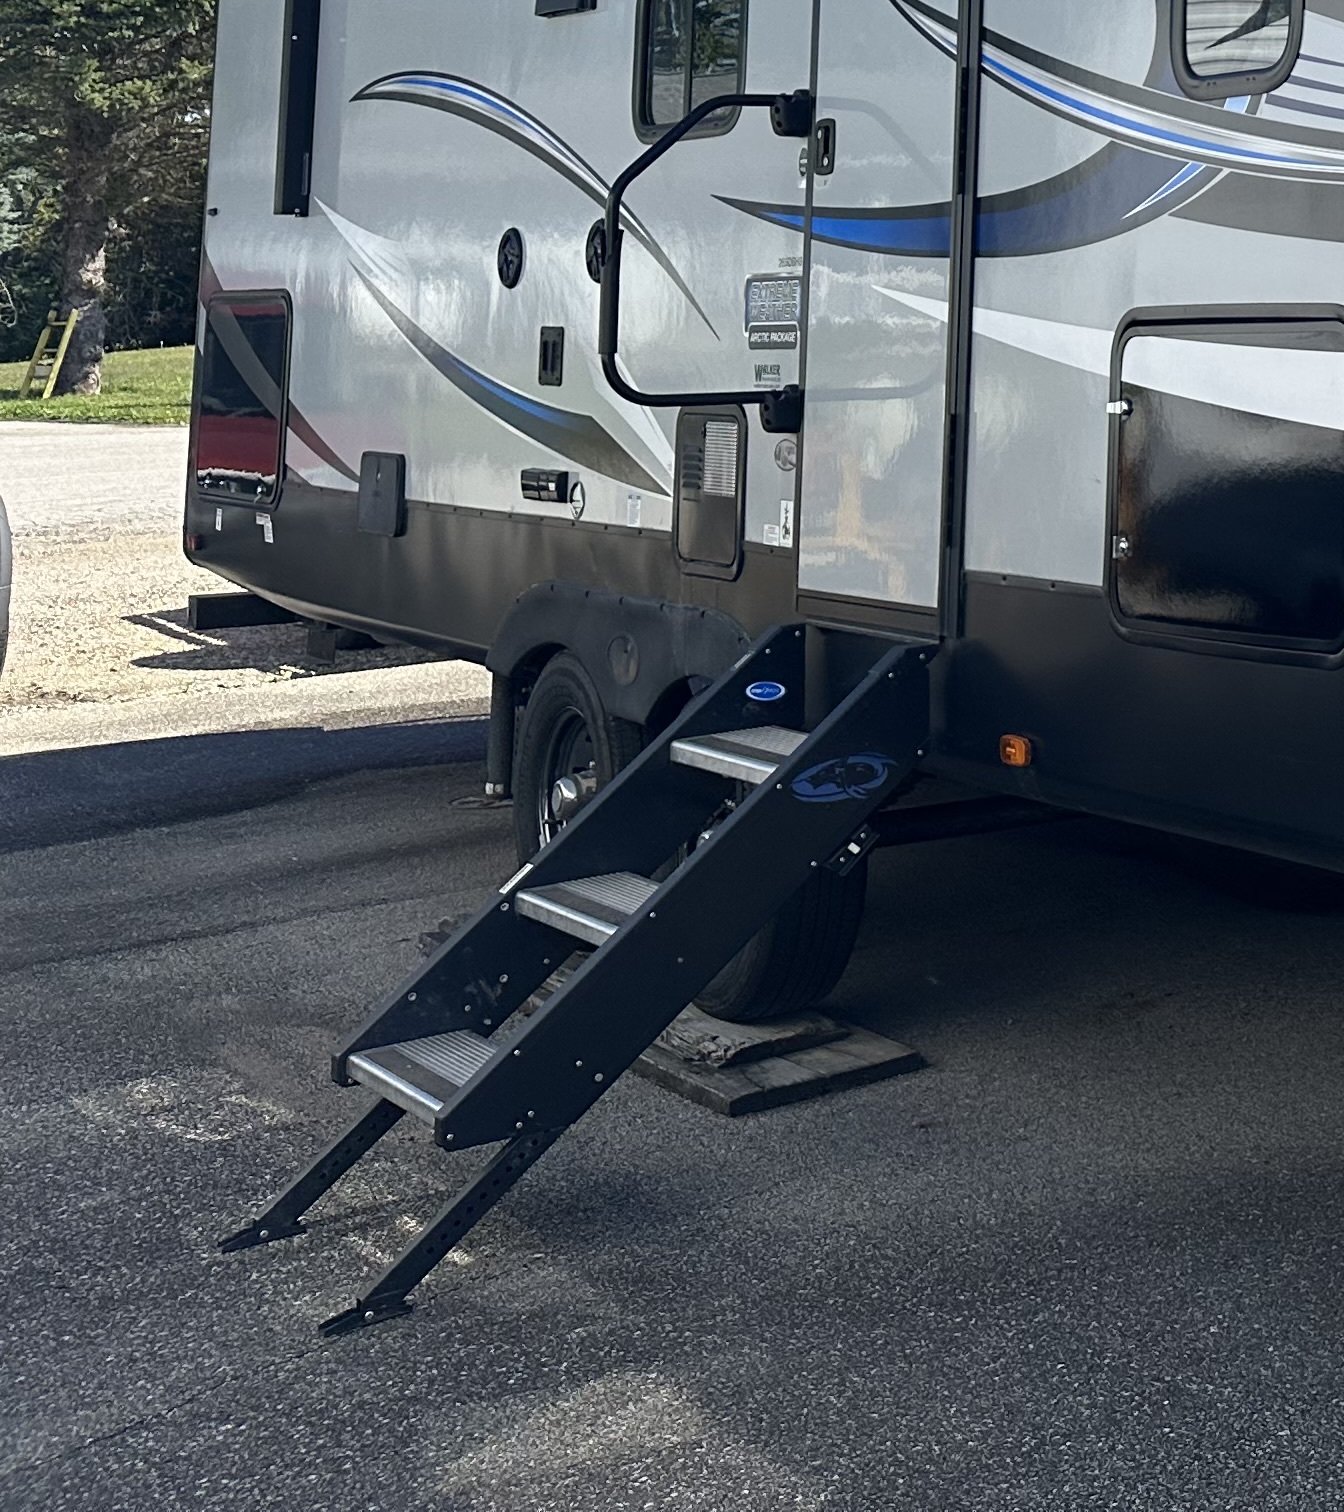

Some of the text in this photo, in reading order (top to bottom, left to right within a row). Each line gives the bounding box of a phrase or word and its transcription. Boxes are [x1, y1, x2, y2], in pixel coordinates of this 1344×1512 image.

[751, 280, 799, 301] EXTREME
[749, 301, 798, 320] WEATHER
[750, 331, 796, 342] ARCTIC PACKAGE
